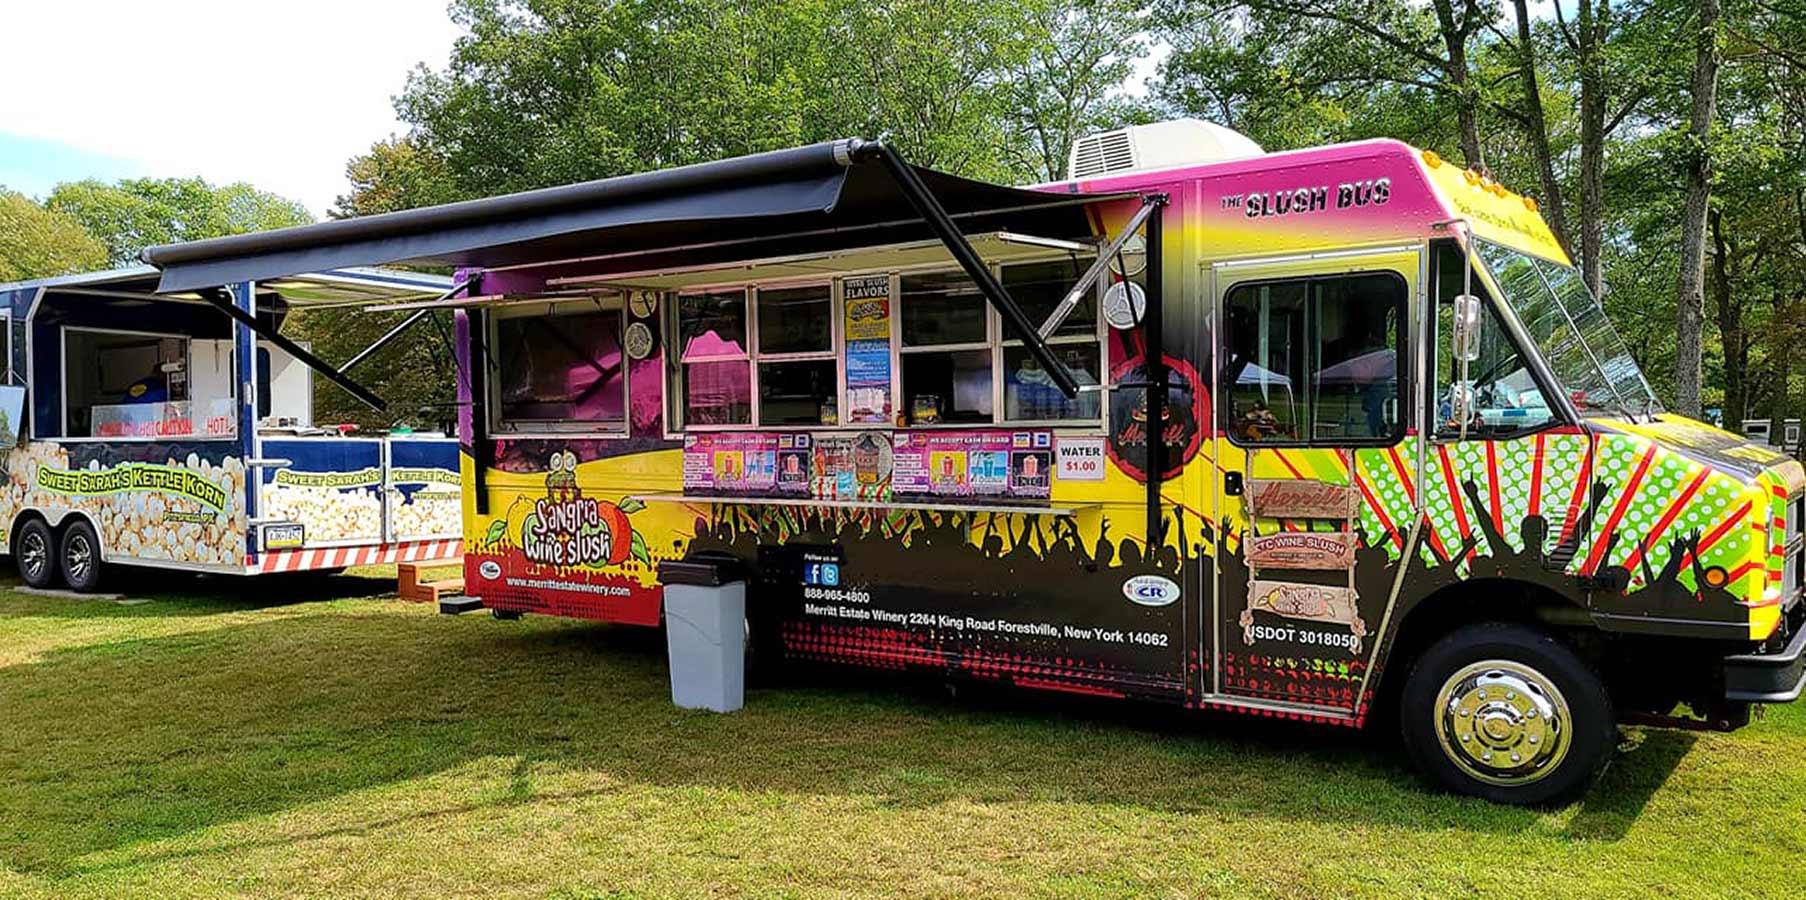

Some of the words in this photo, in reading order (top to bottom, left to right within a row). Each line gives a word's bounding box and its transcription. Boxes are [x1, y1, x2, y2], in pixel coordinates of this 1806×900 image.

[1221, 194, 1243, 209] THE
[1245, 186, 1329, 218] SLUSH
[1337, 178, 1392, 209] BUS
[846, 286, 889, 299] FLAVORS
[1061, 447, 1101, 457] WATER
[1066, 461, 1097, 471] $1.00
[277, 471, 324, 485] SWEET
[39, 468, 78, 492] SWEET
[79, 468, 131, 492] SARAH'S
[133, 467, 184, 491] KETTLE
[185, 473, 225, 510] KORN
[1275, 537, 1305, 547] WINE
[1307, 537, 1346, 555] SLUSH
[506, 576, 631, 597] www.merrittestatewinery.com
[805, 587, 870, 603] 888-965-4800
[1137, 587, 1164, 598] CR
[805, 603, 838, 617] Merritt
[839, 605, 871, 620] Estate
[872, 609, 908, 624] Winery
[909, 612, 936, 626] 2264
[938, 615, 964, 630] King
[966, 617, 995, 632] Road
[998, 619, 1062, 639] Forestville,
[1064, 626, 1092, 640] New
[1094, 628, 1124, 643] York
[1128, 631, 1169, 647] 14062
[1246, 625, 1296, 642] USDOT
[1299, 630, 1359, 648] 3018050
